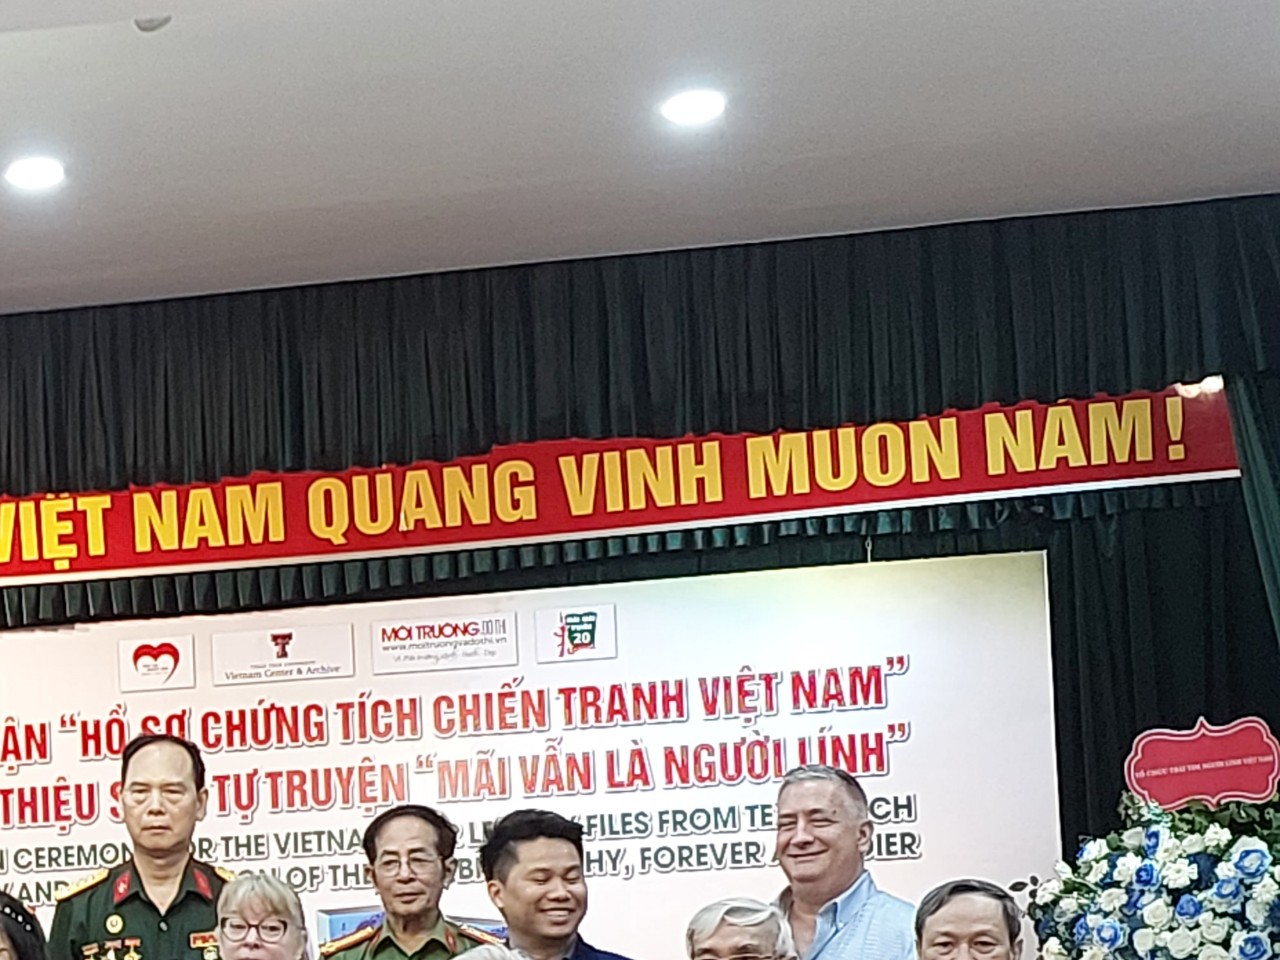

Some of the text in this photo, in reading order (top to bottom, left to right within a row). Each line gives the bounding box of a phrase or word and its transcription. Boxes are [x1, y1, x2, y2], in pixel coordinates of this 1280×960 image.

[133, 481, 285, 553] NAM
[307, 458, 538, 545] QUANG
[559, 440, 723, 516] VINH
[572, 632, 592, 645] 20
[200, 698, 325, 749] CHỨNG
[336, 692, 419, 741] TÍCH
[433, 677, 547, 736] CHIẾN
[558, 679, 686, 726] TRANH
[698, 665, 780, 724] VIỆT
[212, 768, 258, 820] TỰ
[265, 756, 406, 813] TRUYỆN
[518, 736, 591, 795] VẪN
[606, 739, 651, 789] LÀ
[664, 729, 784, 786] NGƯỜI
[13, 842, 134, 869] CEREMON
[220, 834, 266, 858] THE
[274, 829, 365, 855] VIETNA
[658, 805, 737, 833] FROM
[286, 866, 321, 890] OF
[640, 841, 762, 871] FOREVER
